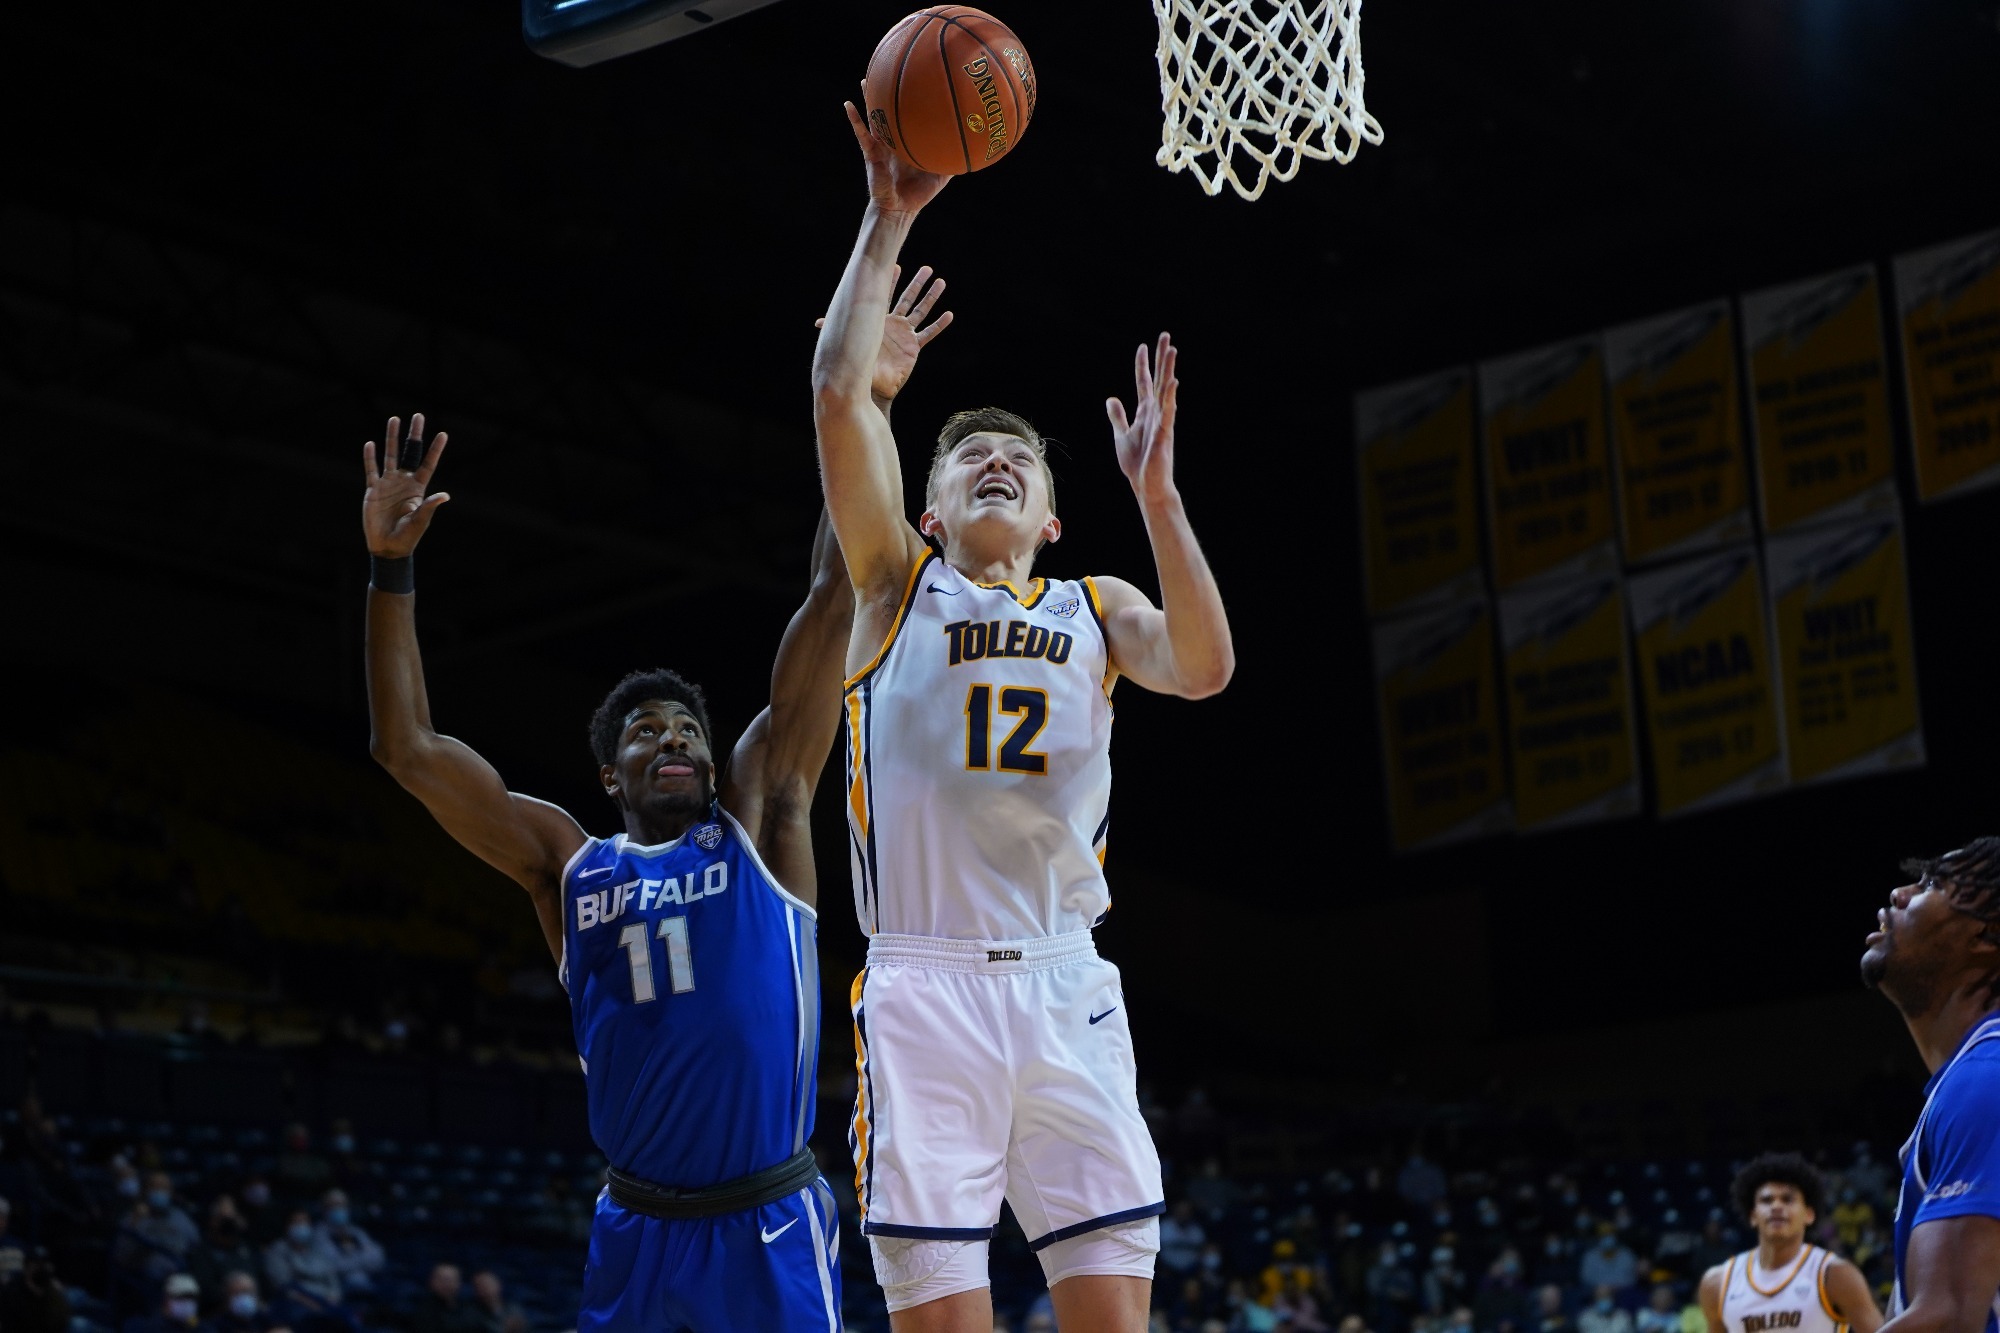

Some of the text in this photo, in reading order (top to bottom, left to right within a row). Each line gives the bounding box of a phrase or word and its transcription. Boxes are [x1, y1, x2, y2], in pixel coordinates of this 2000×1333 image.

[963, 56, 1007, 161] SPALDING
[944, 619, 1073, 667] TOLEDO
[1656, 634, 1752, 695] NCAA
[964, 683, 1048, 776] 12
[576, 861, 728, 932] BUFFALO
[617, 915, 696, 1005] 11
[987, 950, 1022, 963] TOLEDO
[1741, 1310, 1802, 1333] TOLEDO
